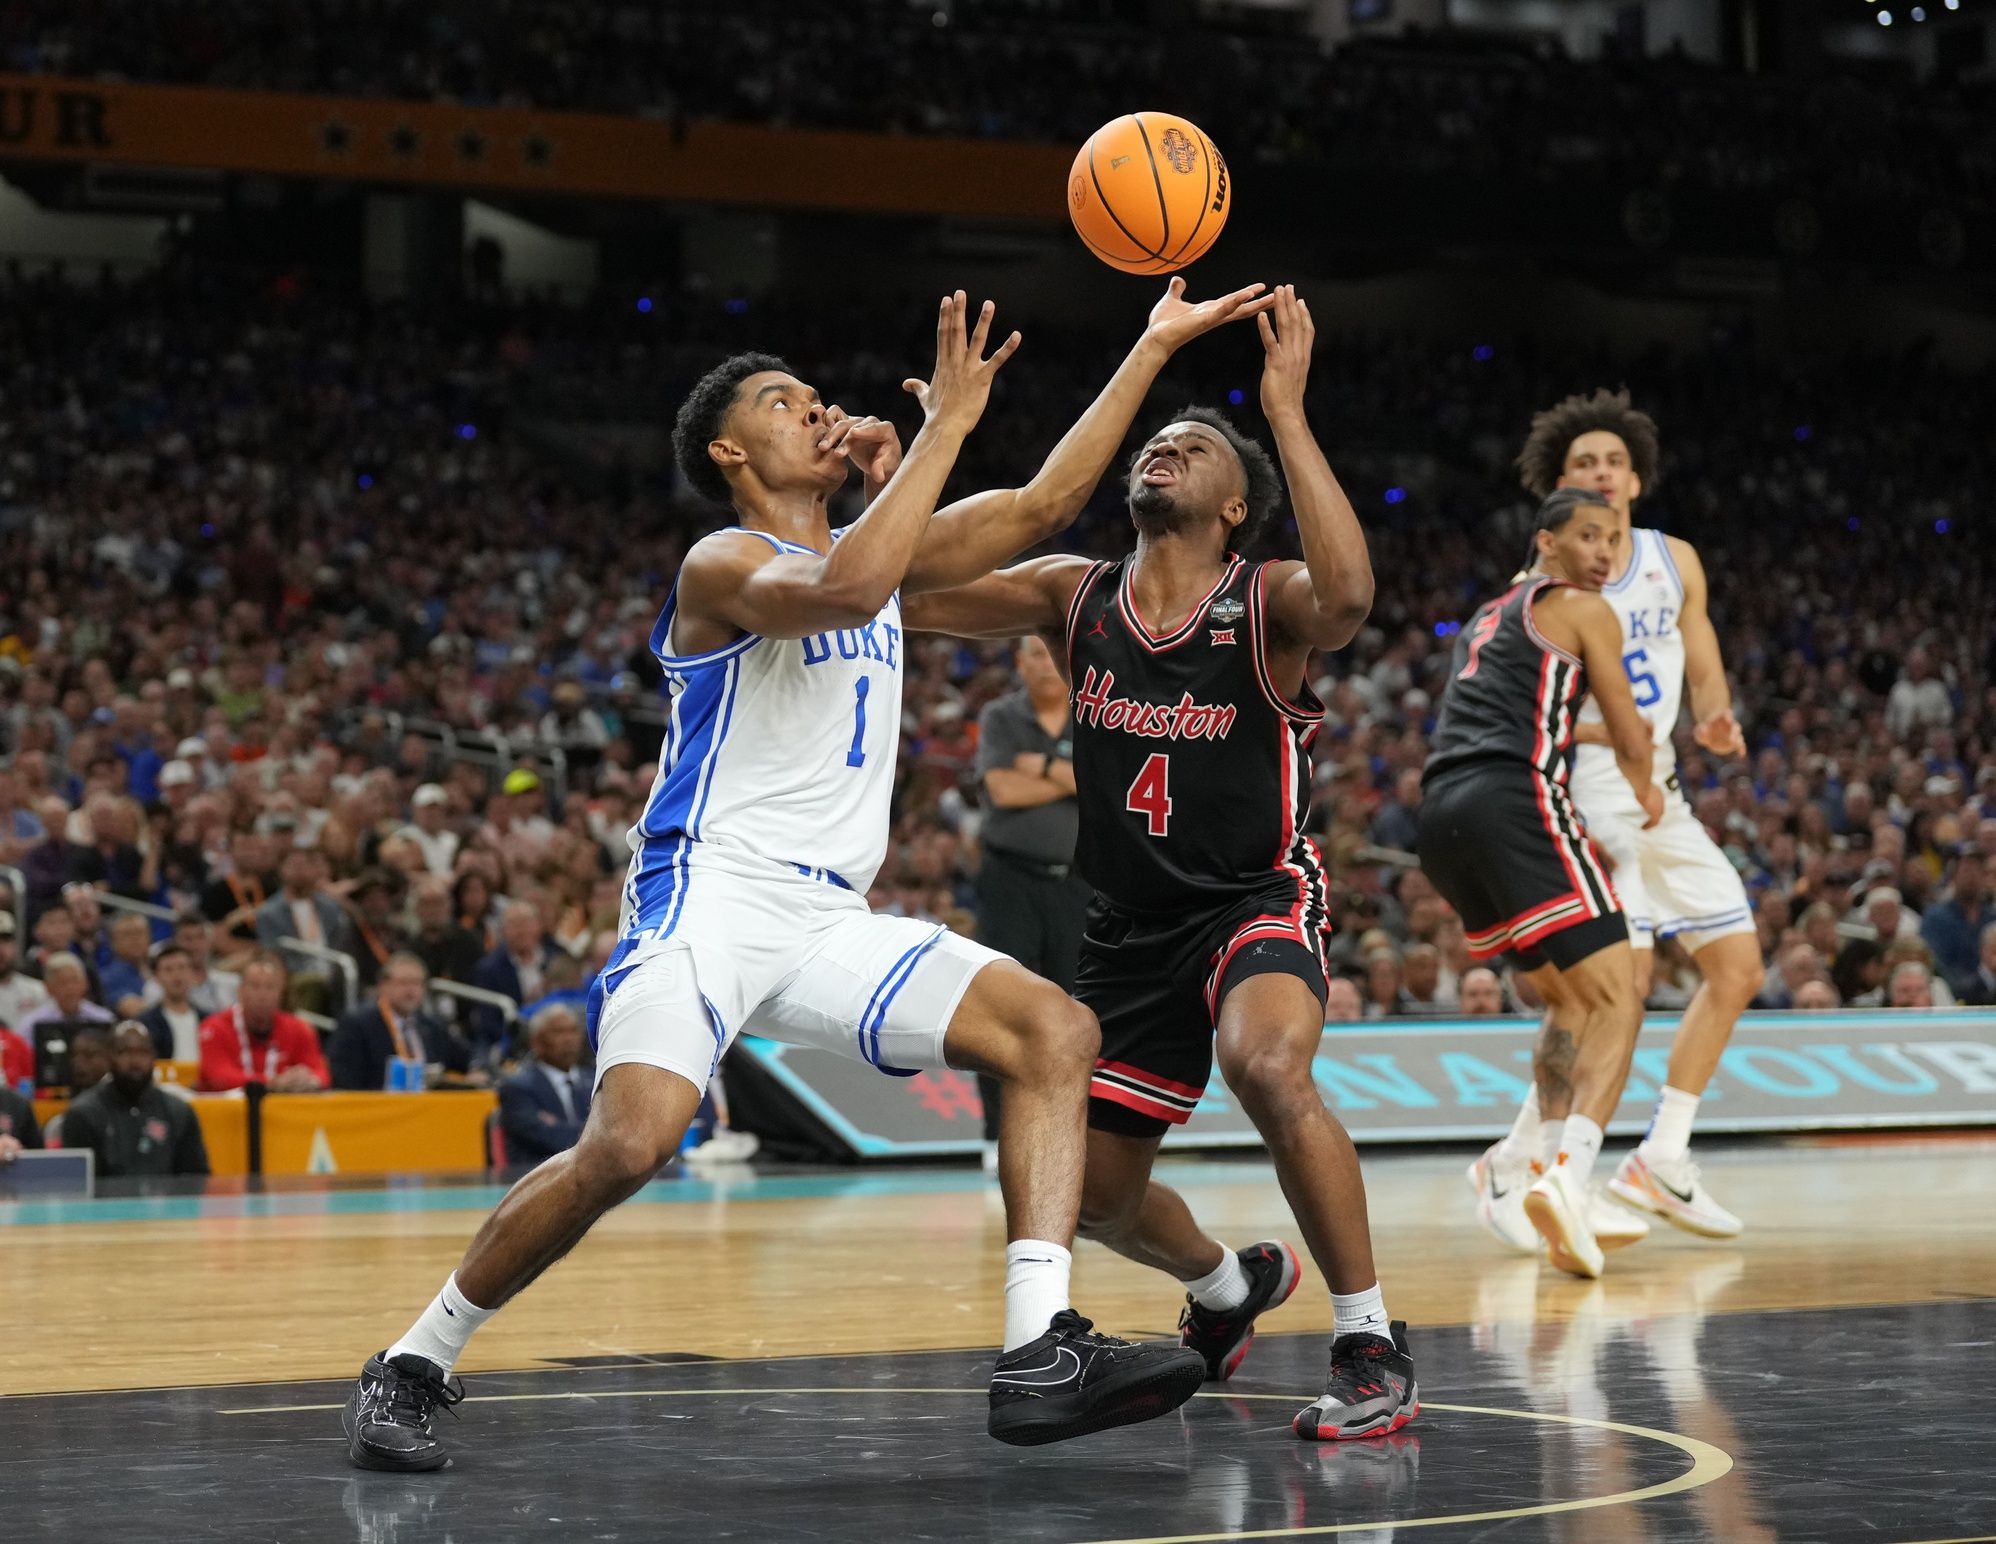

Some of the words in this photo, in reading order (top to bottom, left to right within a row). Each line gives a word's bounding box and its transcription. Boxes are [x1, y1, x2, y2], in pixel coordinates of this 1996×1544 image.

[1228, 605, 1243, 613] FOUR
[1629, 606, 1674, 639] KE
[802, 618, 899, 671] DUKE
[1076, 664, 1237, 742] Houston
[1622, 649, 1661, 707] 5
[846, 675, 870, 768] 1
[1126, 752, 1172, 837] 4
